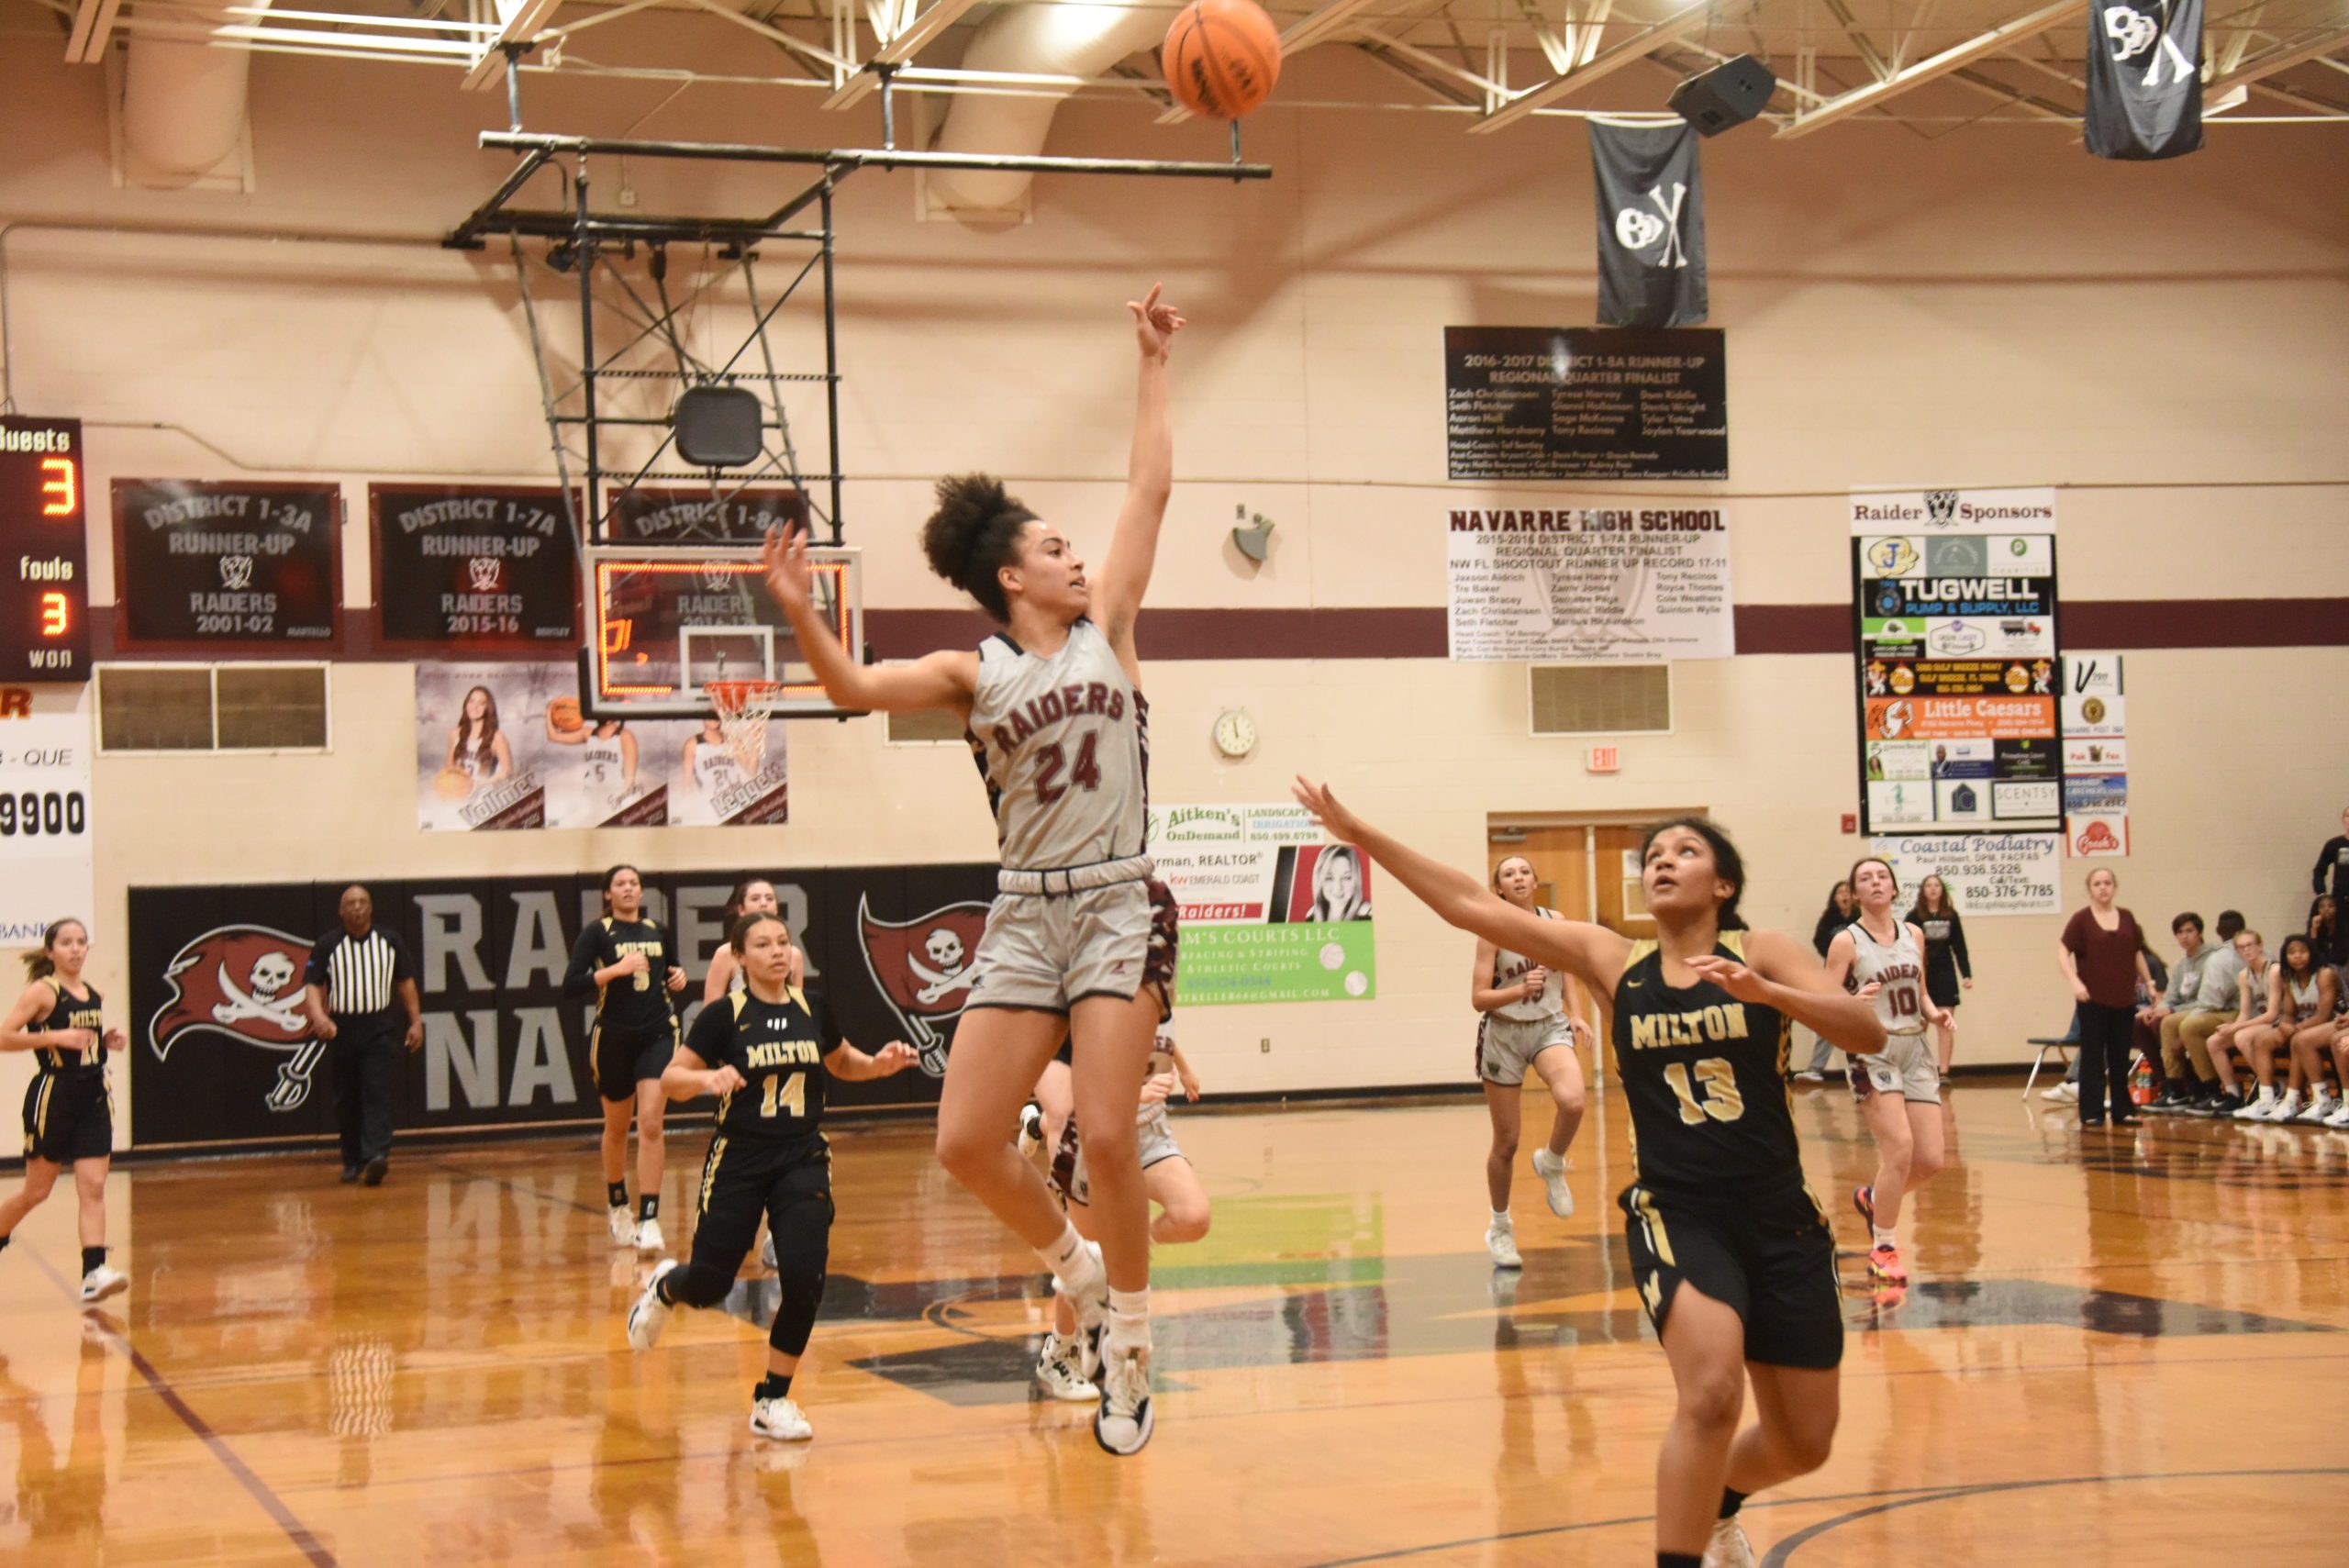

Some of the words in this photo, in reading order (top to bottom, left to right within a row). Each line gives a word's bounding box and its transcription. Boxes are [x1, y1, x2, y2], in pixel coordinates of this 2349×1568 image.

[1464, 355, 1533, 367] 2016-2017
[1537, 355, 1594, 367] DISRICT
[1629, 356, 1705, 368] RUNNER-UP
[1562, 373, 1622, 384] QUARTER
[1625, 373, 1681, 384] FINALIST
[41, 458, 76, 516] 3
[144, 494, 250, 531] DISTRICT
[260, 498, 313, 534] 1-3A
[397, 498, 498, 534] DISTRICT
[507, 502, 557, 537] 1-7A
[635, 502, 730, 538] DISTRICT
[1450, 510, 1571, 532] NAVARRE
[1580, 510, 1633, 531] HIGH
[1641, 510, 1726, 532] SCHOOL
[1854, 504, 1923, 521] Raider
[1960, 503, 2054, 523] Sponsors
[169, 532, 296, 556] RUNNER-UP
[421, 535, 541, 557] RUNNER-UP
[1476, 534, 1535, 544] 2015-2016
[1538, 533, 1595, 544] DISTRICT
[1599, 533, 1625, 544] 1-7A
[1628, 533, 1700, 544] RUNNER-UP
[1495, 545, 1560, 557] REGIONAL
[1564, 545, 1625, 557] QUARTER
[1628, 545, 1683, 556] FINALIST
[1450, 559, 1471, 569] NW
[1475, 559, 1489, 569] FL
[1493, 558, 1562, 570] SHOOTOUT
[1565, 558, 1620, 569] RUNNER
[1622, 558, 1641, 569] UP
[1643, 558, 1695, 568] RECORD
[1698, 558, 1727, 568] 17-11
[1898, 579, 2039, 601] TUGWELL
[190, 593, 277, 614] RAIDERS
[441, 594, 523, 614] RAIDERS
[1905, 602, 1943, 615] PUMP
[2015, 601, 2039, 614] LLC
[42, 593, 67, 636] 3
[195, 615, 273, 633] 2001-02
[447, 616, 519, 633] 2015-16
[28, 649, 72, 669] won
[1924, 700, 1971, 717] Little
[1976, 699, 2042, 717] Caesars
[992, 682, 1125, 756] RAIDERS
[24, 749, 72, 766] QUE
[1034, 728, 1101, 806] 24
[1592, 748, 1617, 768] EXIT
[460, 773, 536, 827] Vollmer
[1996, 786, 2056, 800] SCENTSY
[0, 792, 84, 836] 9900
[1168, 807, 1241, 828] Aitken's
[1166, 830, 1240, 841] OnDemand
[1900, 835, 1968, 854] Coastal
[1973, 834, 2054, 854] Podiatry
[1916, 855, 1936, 863] Paul
[1189, 873, 1230, 884] EMERALD
[1232, 873, 1260, 884] COAST
[1935, 864, 2022, 876] 850.936.5226
[1965, 884, 2054, 898] 850-376-7785
[1178, 904, 1246, 918] Raiders!
[413, 884, 819, 994] RAER
[1182, 930, 1218, 946] M'S
[1223, 929, 1299, 943] COURTS
[1305, 928, 1340, 941] LLC
[1865, 963, 1922, 985] AIDER
[1887, 986, 1918, 1018] 10
[1630, 1002, 1749, 1051] MILTON
[746, 1040, 820, 1069] MILTON
[760, 1072, 806, 1118] 14
[1663, 1057, 1745, 1127] 13
